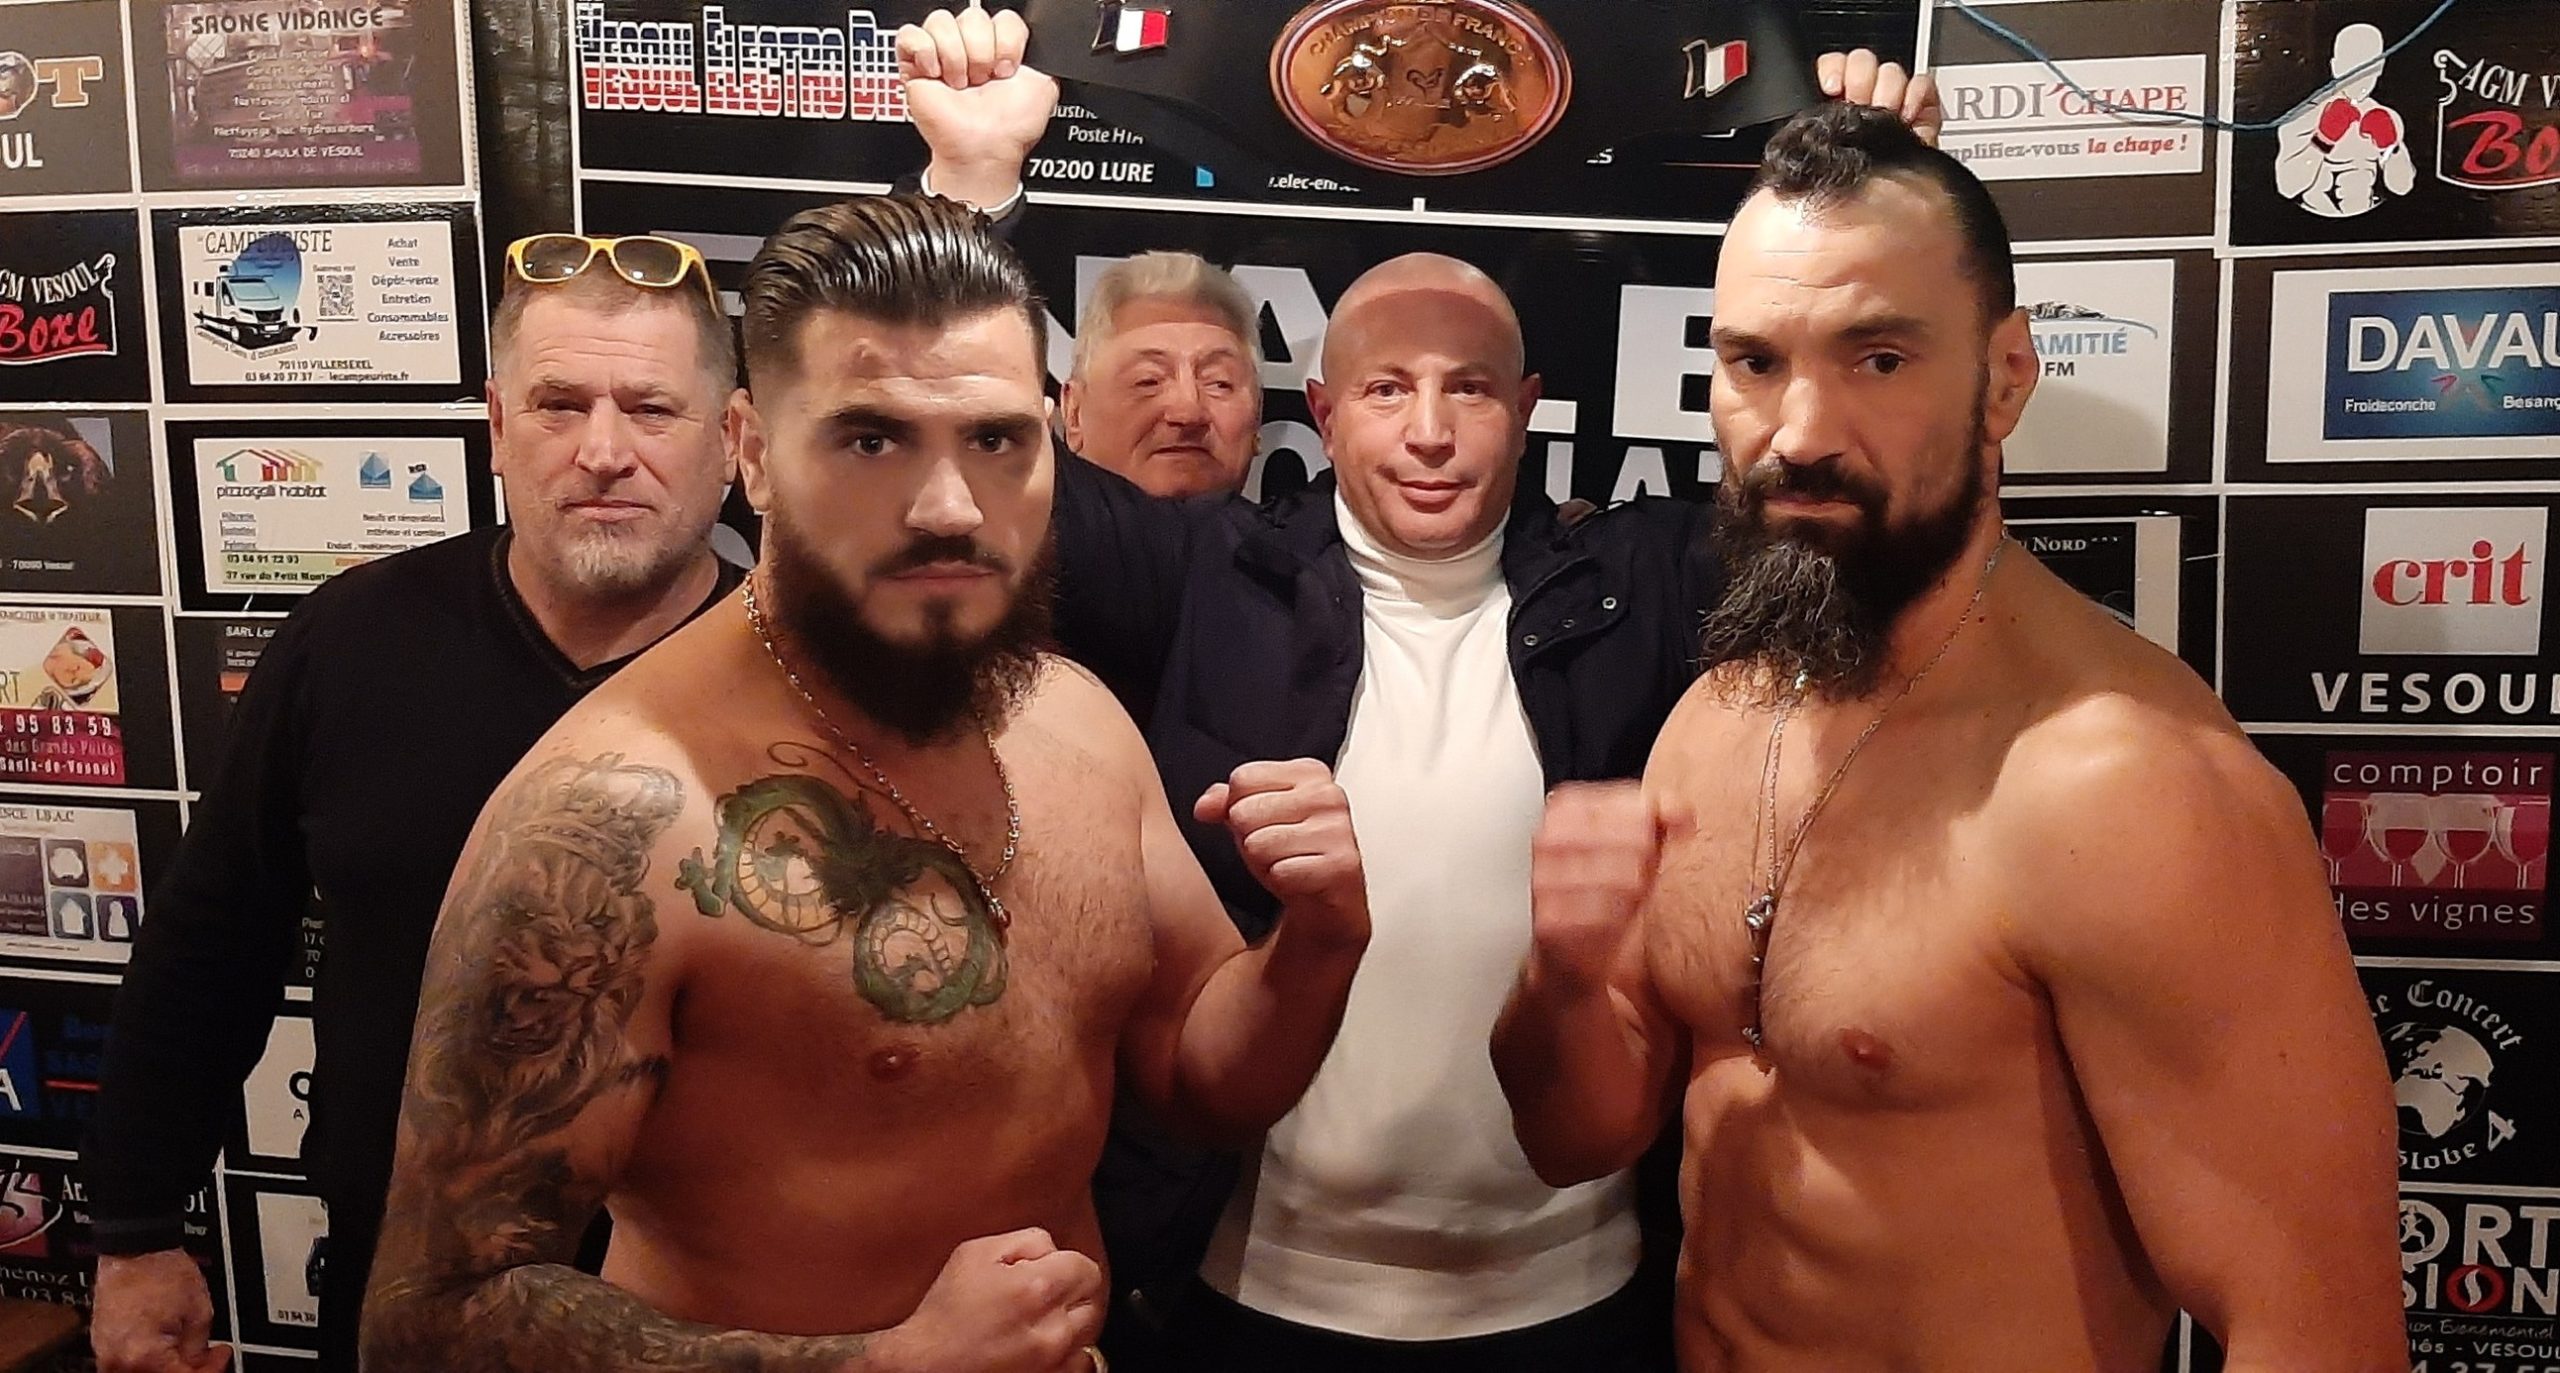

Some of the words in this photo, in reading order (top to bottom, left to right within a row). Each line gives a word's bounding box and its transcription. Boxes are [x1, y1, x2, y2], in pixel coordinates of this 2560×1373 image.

[278, 6, 384, 31] VIDANGE
[576, 3, 702, 113] VESOUL
[703, 6, 845, 120] ELECTRO
[2459, 58, 2531, 107] AGM
[1068, 126, 1109, 143] Poste
[321, 146, 364, 158] VESOUL
[2087, 136, 2107, 154] la
[2113, 135, 2175, 156] chape
[1028, 159, 1095, 181] 70200
[1100, 161, 1155, 183] LURE
[388, 238, 418, 249] Achat
[388, 256, 420, 267] Vente
[31, 261, 100, 304] VESOUL
[382, 293, 432, 305] Entretien
[367, 312, 449, 323] Consommables
[379, 330, 440, 342] Accessoires
[310, 359, 374, 371] VILLERSEXEL
[2045, 362, 2075, 376] FM
[2345, 398, 2436, 413] Froideconche
[279, 485, 327, 498] habitat
[2372, 540, 2532, 607] crit
[226, 625, 255, 638] SARL
[15, 713, 39, 734] 95
[51, 715, 74, 736] 83
[87, 716, 112, 737] 59
[2333, 757, 2544, 792] comptoir
[2410, 895, 2536, 930] vignes
[2406, 979, 2524, 1051] Concert
